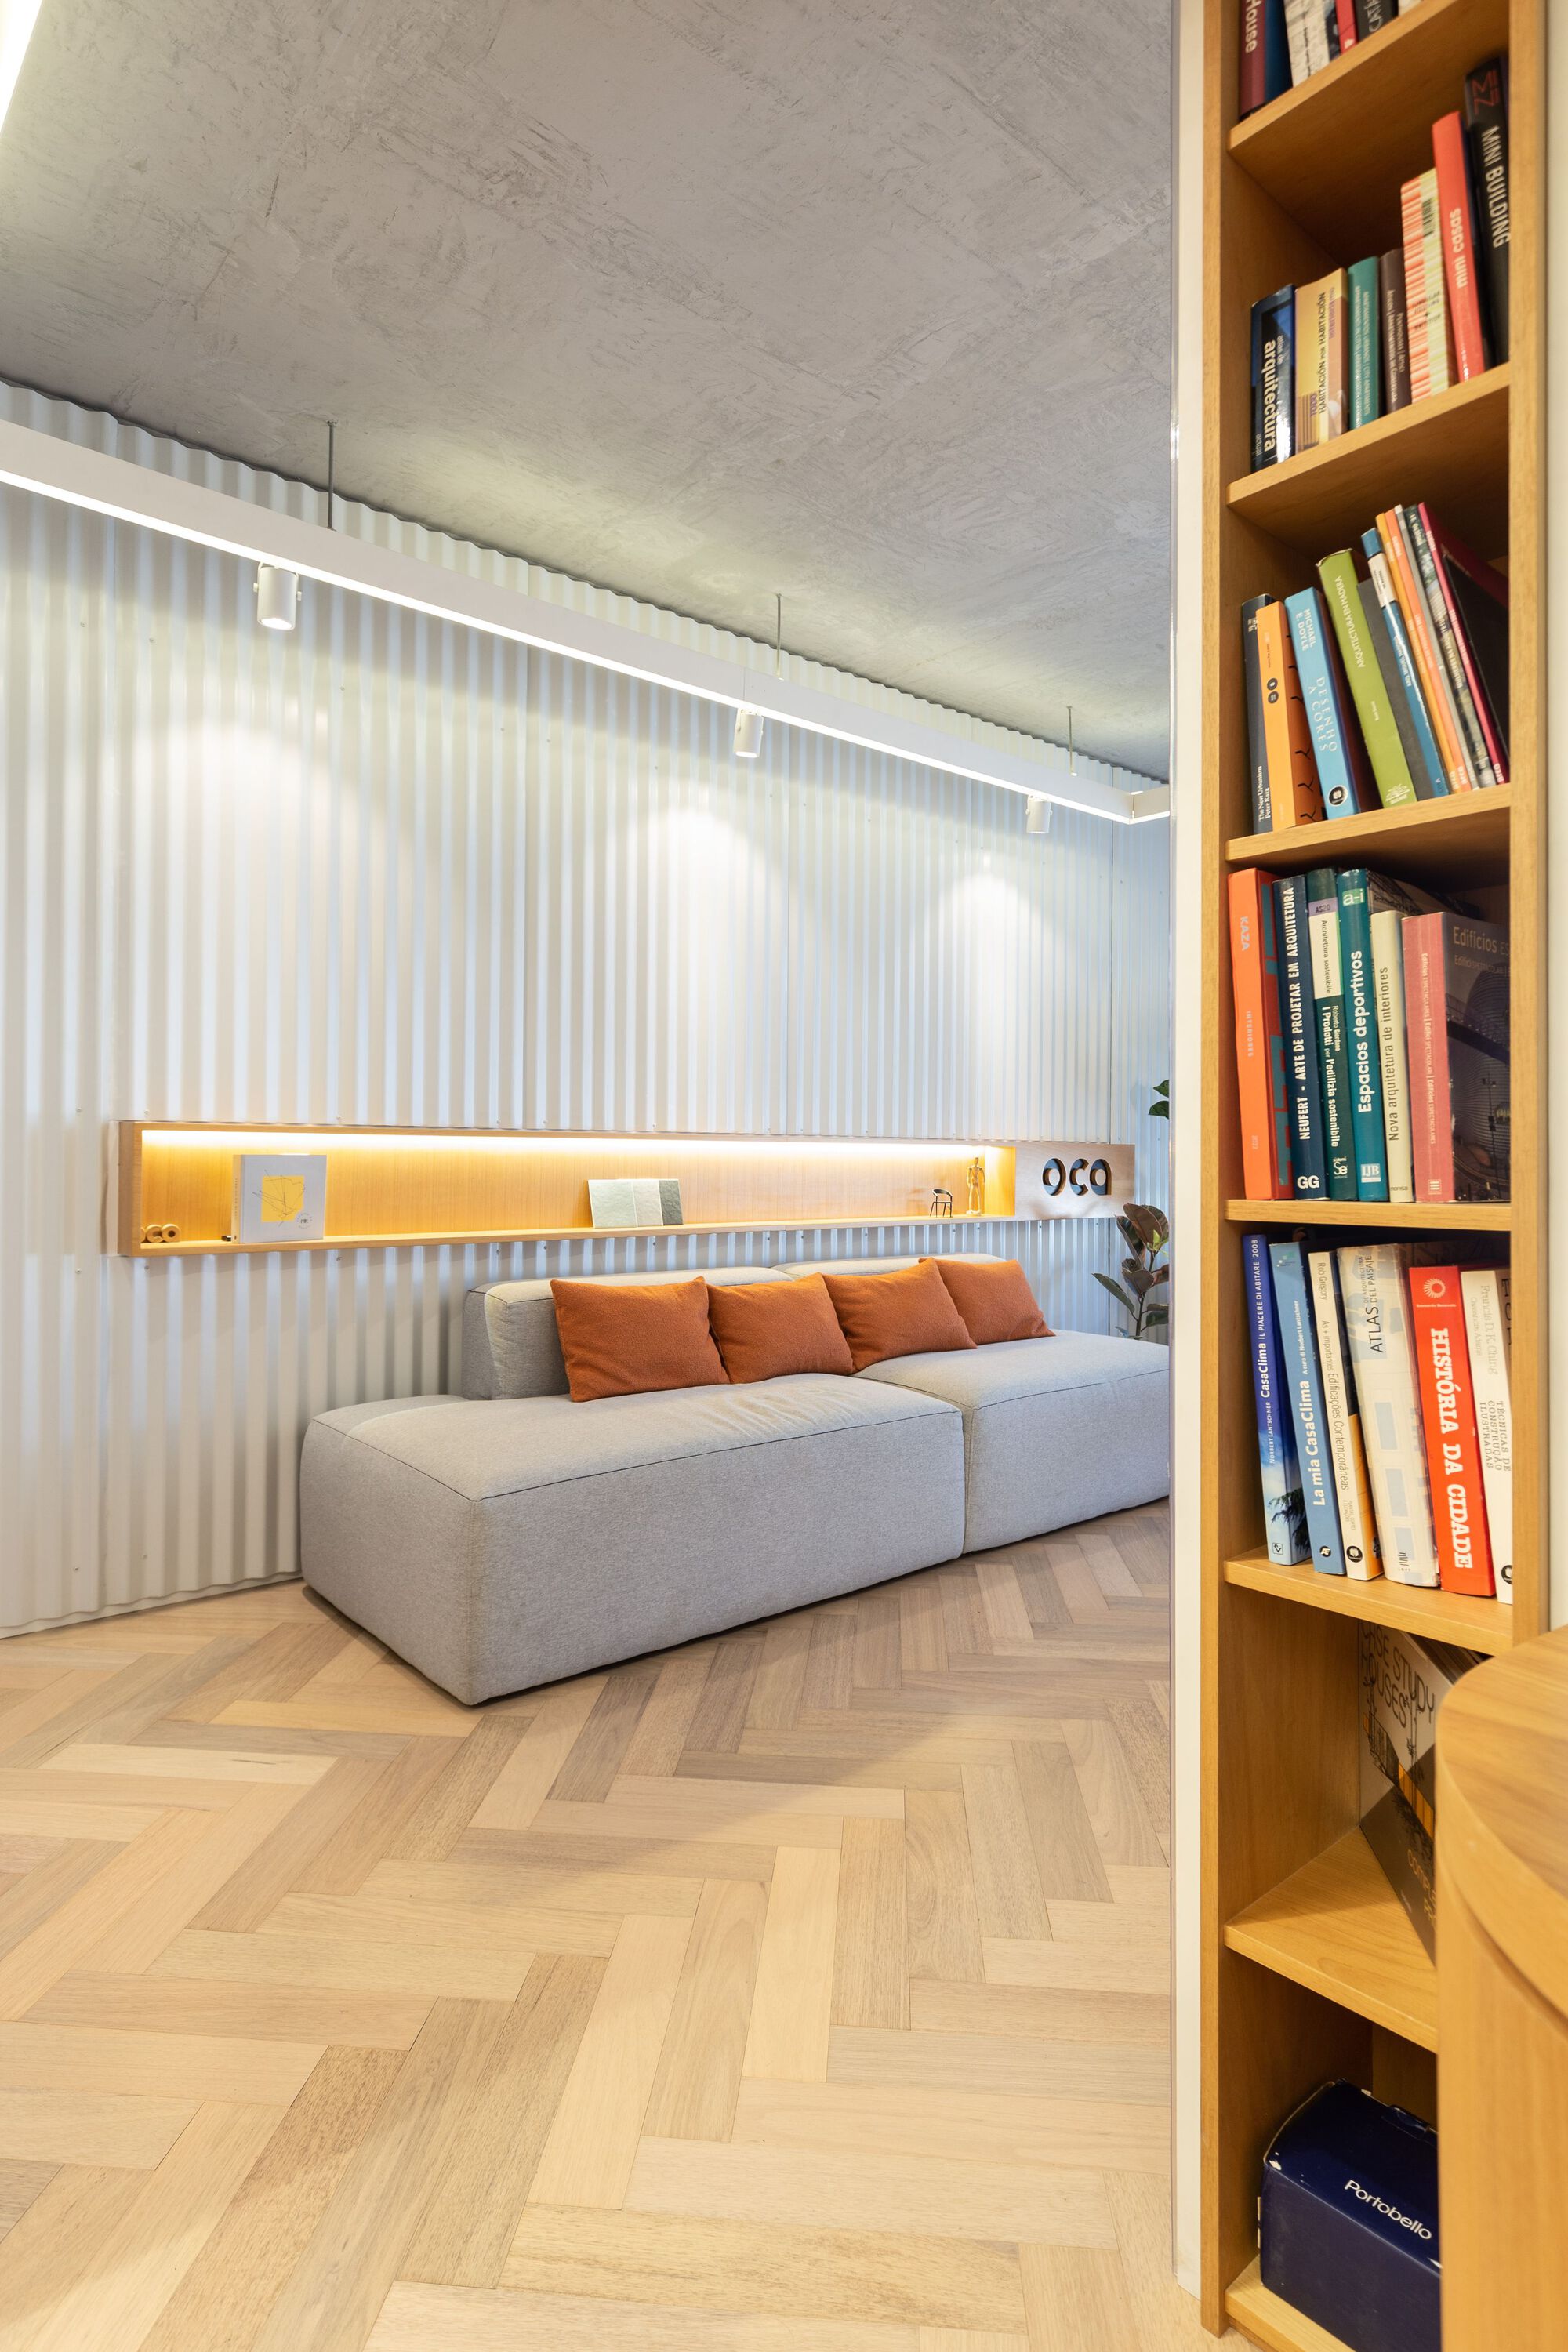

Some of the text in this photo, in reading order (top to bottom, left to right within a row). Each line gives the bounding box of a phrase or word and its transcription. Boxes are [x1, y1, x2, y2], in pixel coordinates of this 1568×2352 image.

[1483, 126, 1510, 246] MINI BUILDING
[1450, 208, 1466, 288] mini casas
[1262, 338, 1279, 450] arquitectura
[1317, 361, 1326, 413] HABITACIÓN
[1298, 621, 1308, 650] DOYLE
[1303, 608, 1316, 647] MICHAEL
[1334, 575, 1364, 667] ARQUITECTURA EN MADERA
[1312, 701, 1327, 750] CORES
[1316, 677, 1337, 751] DESENHO
[1240, 916, 1250, 951] KAZA
[1283, 887, 1298, 956] ARQUITETURA
[1454, 926, 1497, 953] Edificios
[1287, 962, 1299, 978] EM
[1289, 982, 1302, 1033] PROJETAR
[1350, 951, 1374, 1112] Espacios deportivos
[1292, 1038, 1304, 1051] DE
[1294, 1054, 1306, 1080] ARTE
[1379, 967, 1399, 1141] Nova arquitetura de interiores
[1323, 1011, 1333, 1045] Prodotti
[1328, 1099, 1339, 1146] sostenibile
[1297, 1097, 1310, 1139] NEUFERT
[1042, 1158, 1112, 1196] oca
[1298, 1175, 1319, 1189] GG
[1317, 1261, 1327, 1299] Rob Gregory
[1357, 1255, 1366, 1294] ARQUITECTURA
[1363, 1254, 1377, 1303] DEL PAISAJE
[1256, 1301, 1265, 1336] PIACERE
[1321, 1319, 1330, 1328] As
[1365, 1306, 1383, 1352] ATLAS
[1479, 1284, 1490, 1319] Francis
[1486, 1345, 1497, 1374] Ching
[1260, 1343, 1270, 1399] CasaClima
[1323, 1335, 1334, 1370] importantes
[1327, 1373, 1341, 1418] Edificações
[1431, 1327, 1461, 1434] HISTÓRIA
[1268, 1438, 1276, 1464] NORBERT
[1299, 1381, 1325, 1505] La mia CasaClima
[1333, 1421, 1348, 1490] Contemporâneas
[1442, 1443, 1464, 1475] DA
[1479, 1402, 1493, 1468] ILUSTRADAS
[1446, 1484, 1473, 1569] CIDADE
[1361, 1639, 1406, 1729] HOUSES
[1392, 1646, 1435, 1724] STUDY
[1344, 2180, 1432, 2240] Portobello
